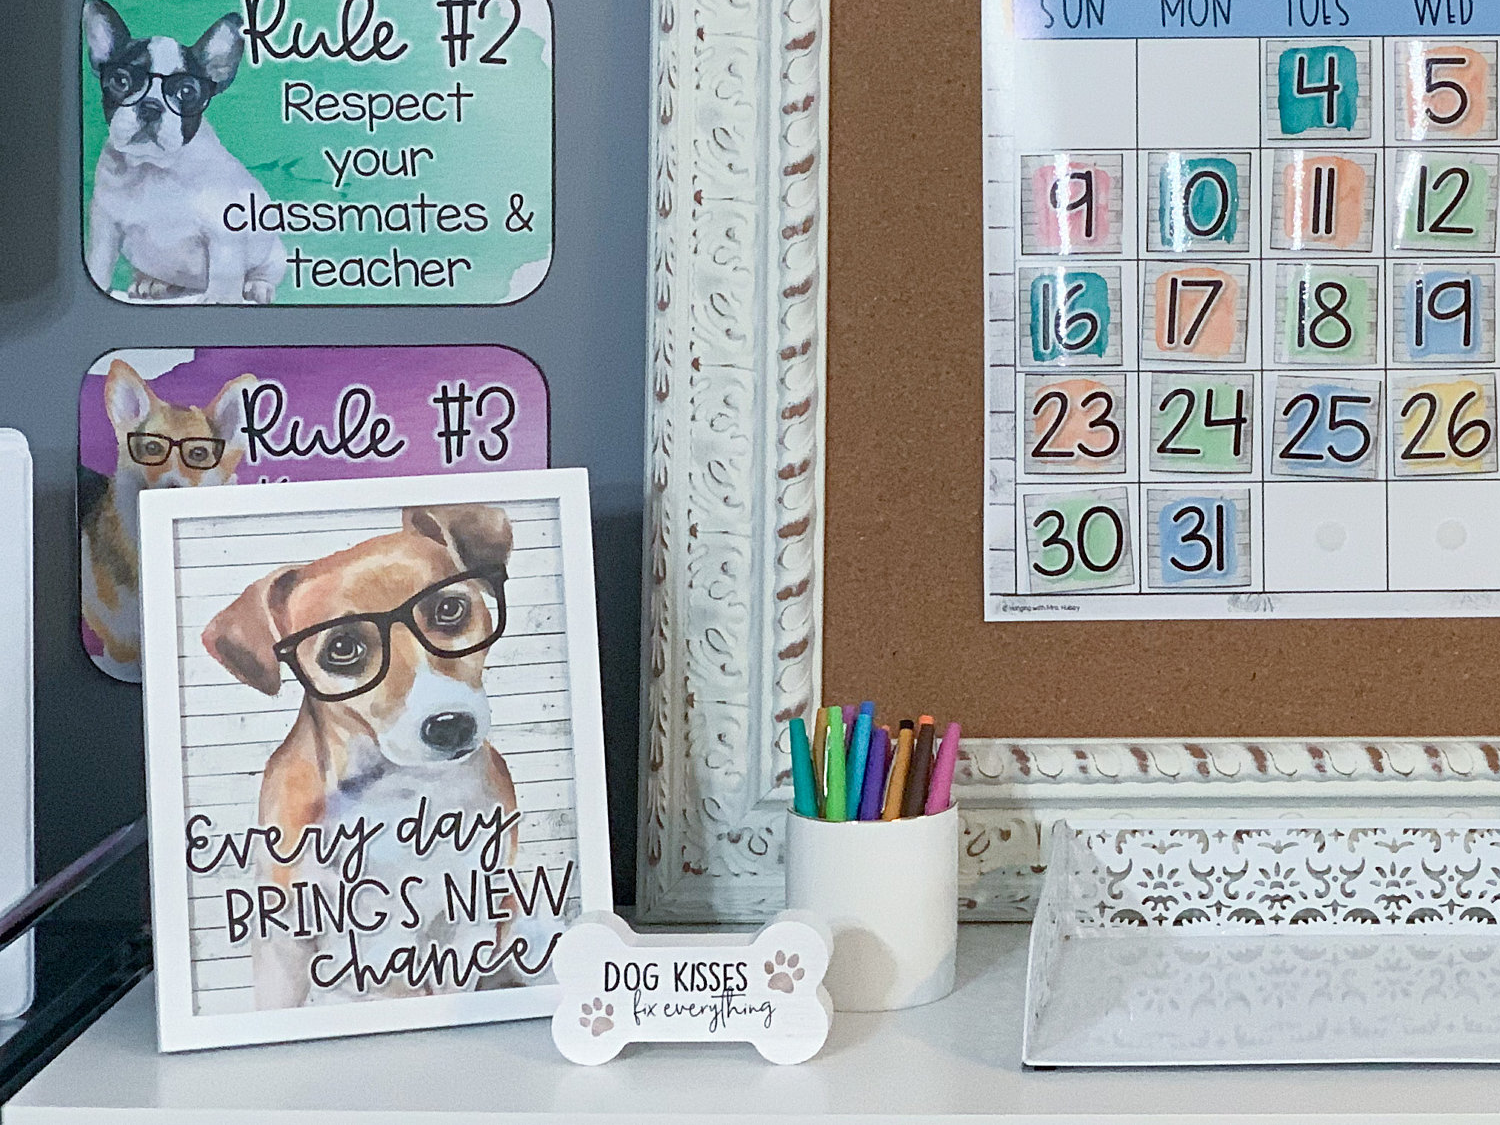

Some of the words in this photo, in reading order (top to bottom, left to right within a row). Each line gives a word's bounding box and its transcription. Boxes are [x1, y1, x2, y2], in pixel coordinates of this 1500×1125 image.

[284, 81, 474, 132] Respect
[1297, 55, 1339, 125] 4
[1425, 57, 1468, 125] 5
[324, 146, 433, 187] your
[1050, 170, 1093, 238] 9
[1312, 167, 1333, 234] 11
[1418, 166, 1474, 234] 12
[222, 192, 488, 234] classmates
[505, 194, 534, 233] &
[285, 248, 471, 289] teacher
[1042, 282, 1098, 352] 16
[1167, 277, 1223, 345] 17
[1297, 280, 1352, 348] 18
[1415, 279, 1471, 347] 19
[240, 383, 405, 463] Rule
[432, 383, 515, 464] #3
[1031, 391, 1121, 459] 23
[1157, 388, 1247, 457] 24
[1279, 393, 1371, 463] 25
[1400, 390, 1492, 460] 26
[1032, 505, 1123, 577] 30
[1169, 503, 1224, 573] 31
[397, 796, 521, 872] day
[225, 876, 423, 943] BRINGS
[445, 861, 574, 922] NEW
[605, 962, 659, 992] DOG
[674, 961, 748, 992] KISSES
[633, 989, 657, 1026] fix
[664, 986, 776, 1033] everything
